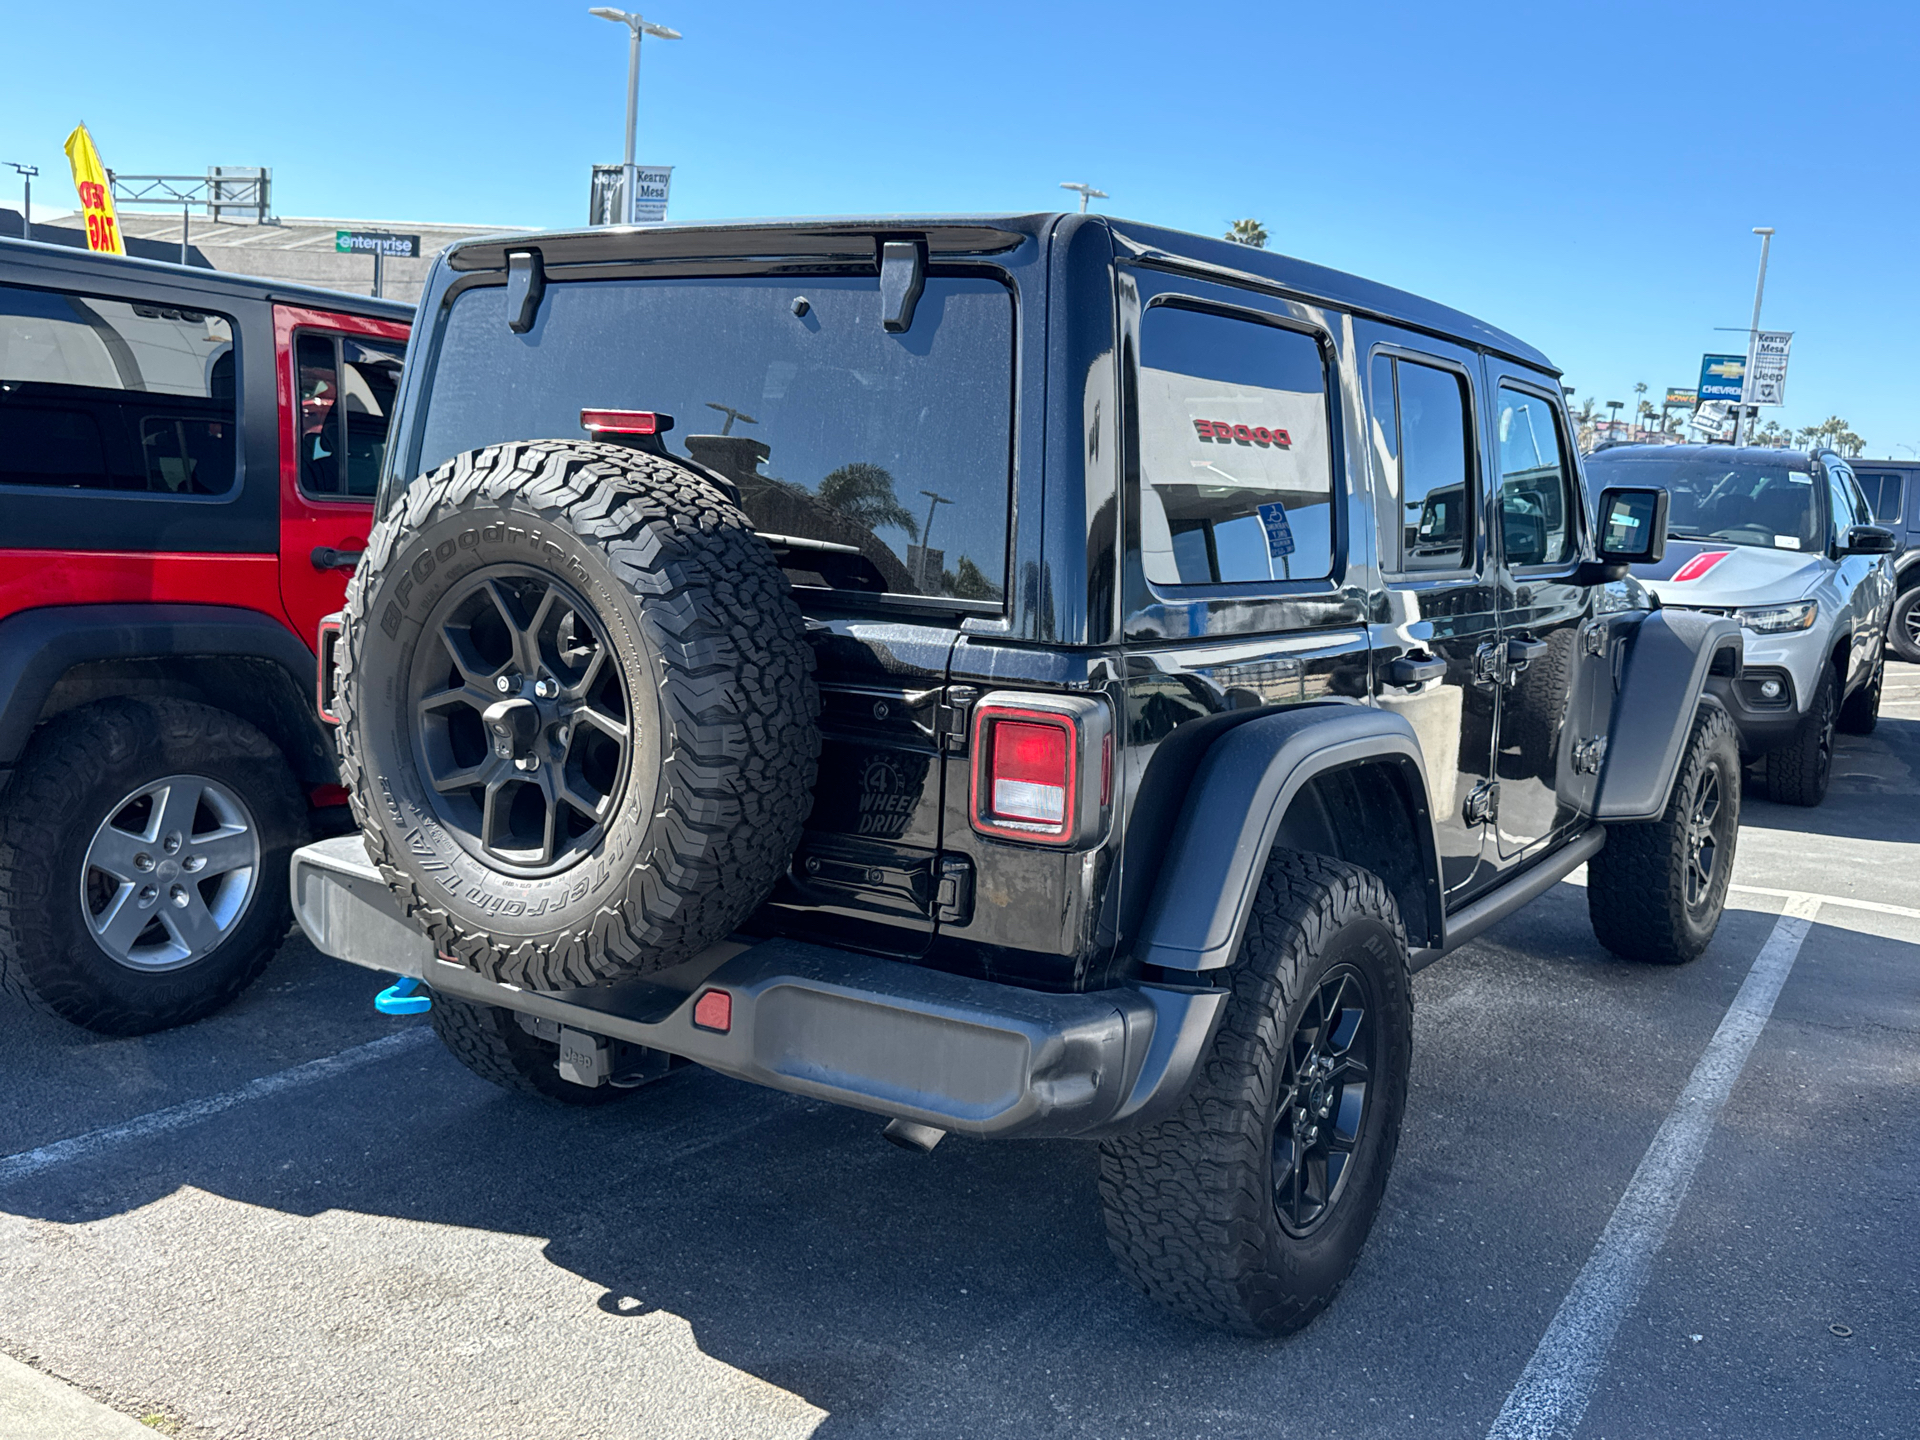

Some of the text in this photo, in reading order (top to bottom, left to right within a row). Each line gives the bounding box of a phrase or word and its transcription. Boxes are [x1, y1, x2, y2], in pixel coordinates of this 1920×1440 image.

[594, 171, 625, 188] Jeep
[637, 170, 670, 187] Kearny
[641, 185, 664, 198] Mesa
[1758, 333, 1790, 346] Kearny
[1760, 343, 1784, 353] Mesa
[1753, 370, 1784, 383] Jeep
[1702, 385, 1742, 396] CHEVROL
[380, 520, 594, 641] BFGoodrich
[869, 767, 888, 793] 4
[859, 793, 919, 814] WHEEL
[857, 813, 913, 834] DRIVE
[463, 780, 643, 918] All-Terrain
[403, 825, 464, 896] T/A
[564, 1046, 593, 1069] Jeep
